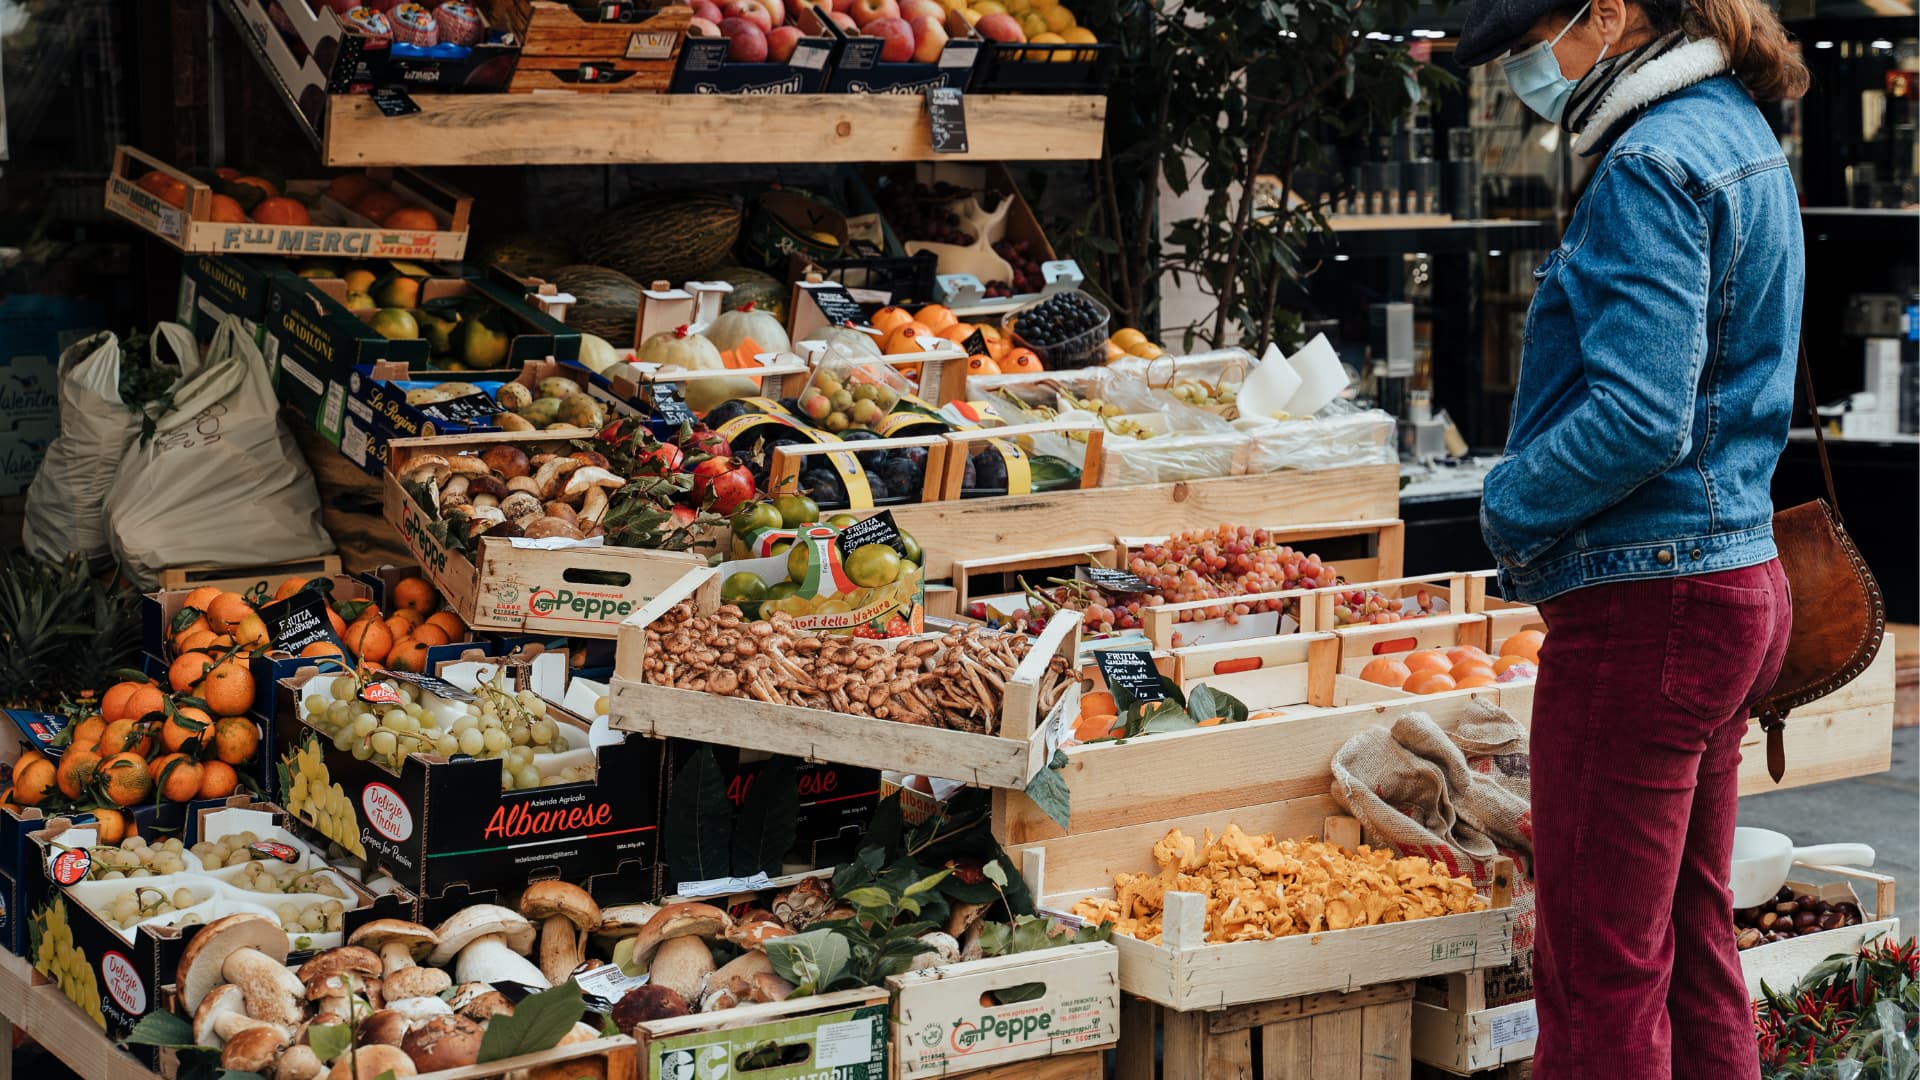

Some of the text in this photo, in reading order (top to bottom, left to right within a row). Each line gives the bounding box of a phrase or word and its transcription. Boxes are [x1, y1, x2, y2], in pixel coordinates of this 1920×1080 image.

[277, 230, 371, 254] MERCI
[282, 313, 335, 362] GRADILONE
[367, 387, 384, 412] La
[384, 400, 417, 434] Regina
[555, 589, 631, 620] Peppe
[820, 616, 849, 627] della
[853, 600, 890, 624] Natura
[1105, 652, 1139, 661] FRUTTA
[370, 787, 403, 820] Delizie
[530, 794, 586, 807] Azienda Agricola
[375, 808, 402, 837] Trani
[484, 800, 612, 840] Albanese
[981, 1013, 1051, 1043] Peppe
